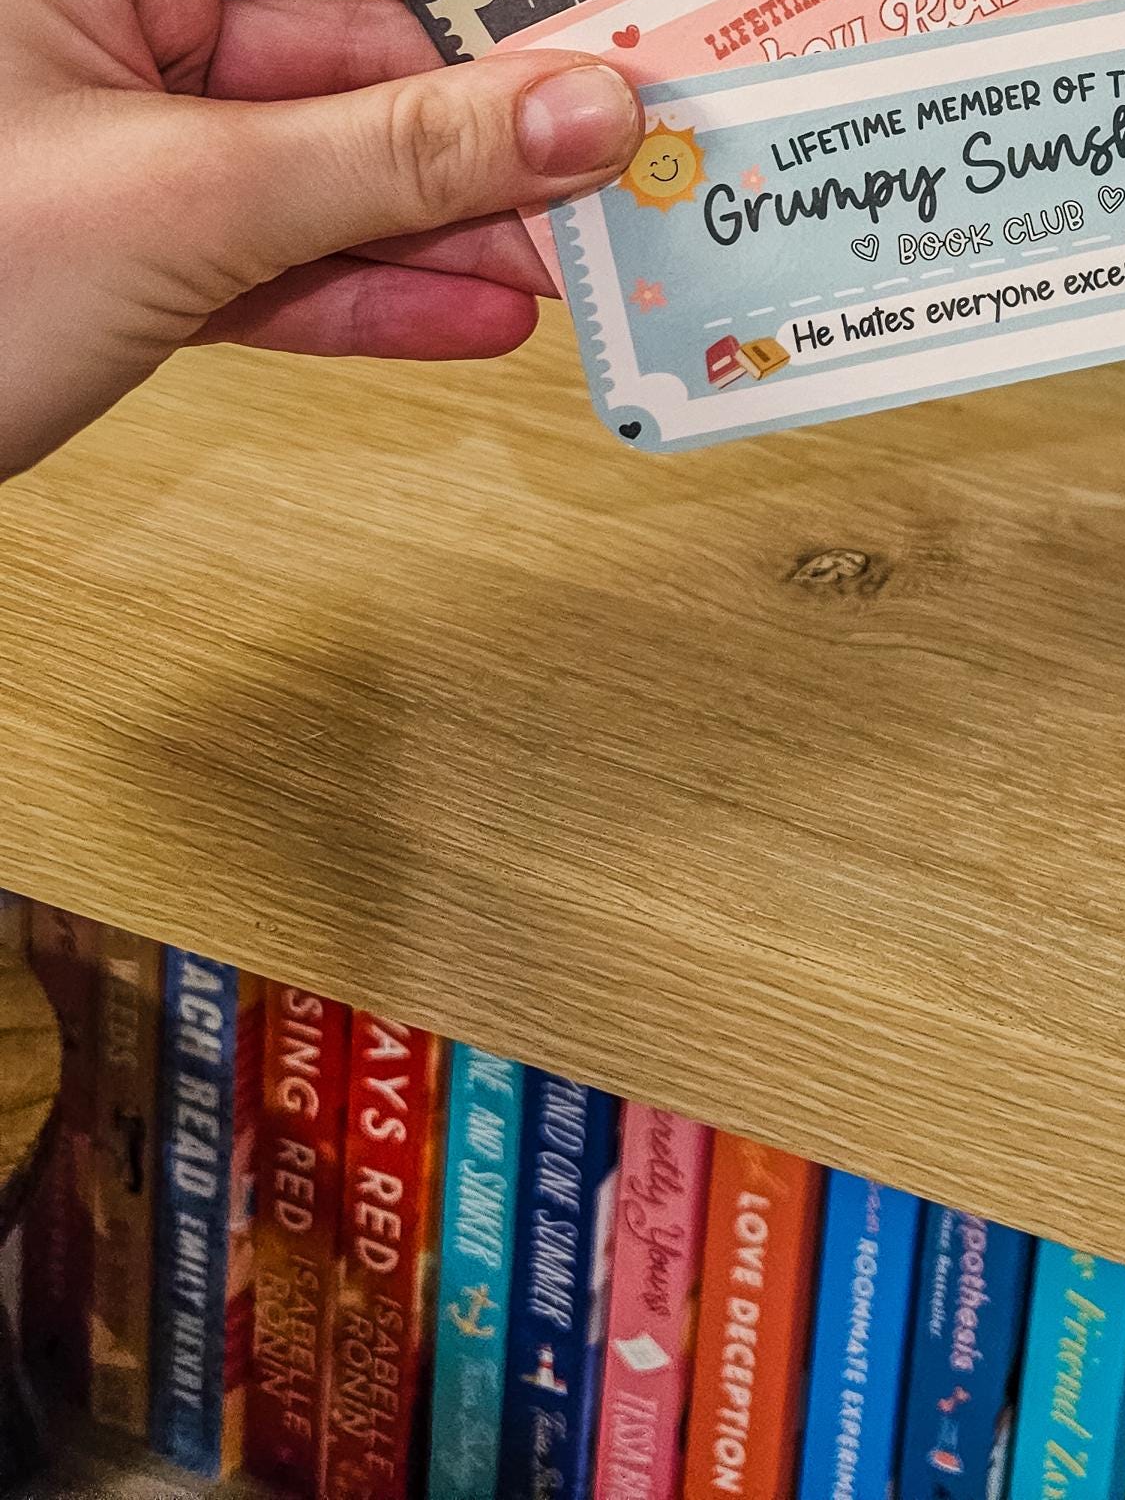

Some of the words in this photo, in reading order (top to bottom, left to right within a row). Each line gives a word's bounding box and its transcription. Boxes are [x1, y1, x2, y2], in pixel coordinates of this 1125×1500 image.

[770, 108, 907, 171] LIFETIME
[917, 79, 1041, 132] MEMBER
[1052, 72, 1096, 105] OF
[703, 162, 947, 247] Grumpy
[897, 223, 993, 265] BOOK
[1003, 200, 1086, 247] CLUB
[792, 322, 835, 354] He
[841, 303, 916, 341] hates
[925, 276, 1056, 327] everyone
[171, 1073, 219, 1199] READ
[273, 1137, 317, 1234] RED
[536, 1150, 584, 1207] ONE
[173, 1211, 209, 1302] EMILY
[354, 1165, 404, 1275] RED
[527, 1208, 580, 1332] SUMMER
[728, 1191, 770, 1289] LOVE
[171, 1306, 206, 1409] HENRY
[282, 1255, 319, 1439] ISABELLE
[842, 1236, 880, 1386] ROOMMATE
[336, 1311, 374, 1436] RONIN
[364, 1294, 404, 1478] ISABELLE
[710, 1296, 761, 1495] DECEPTION
